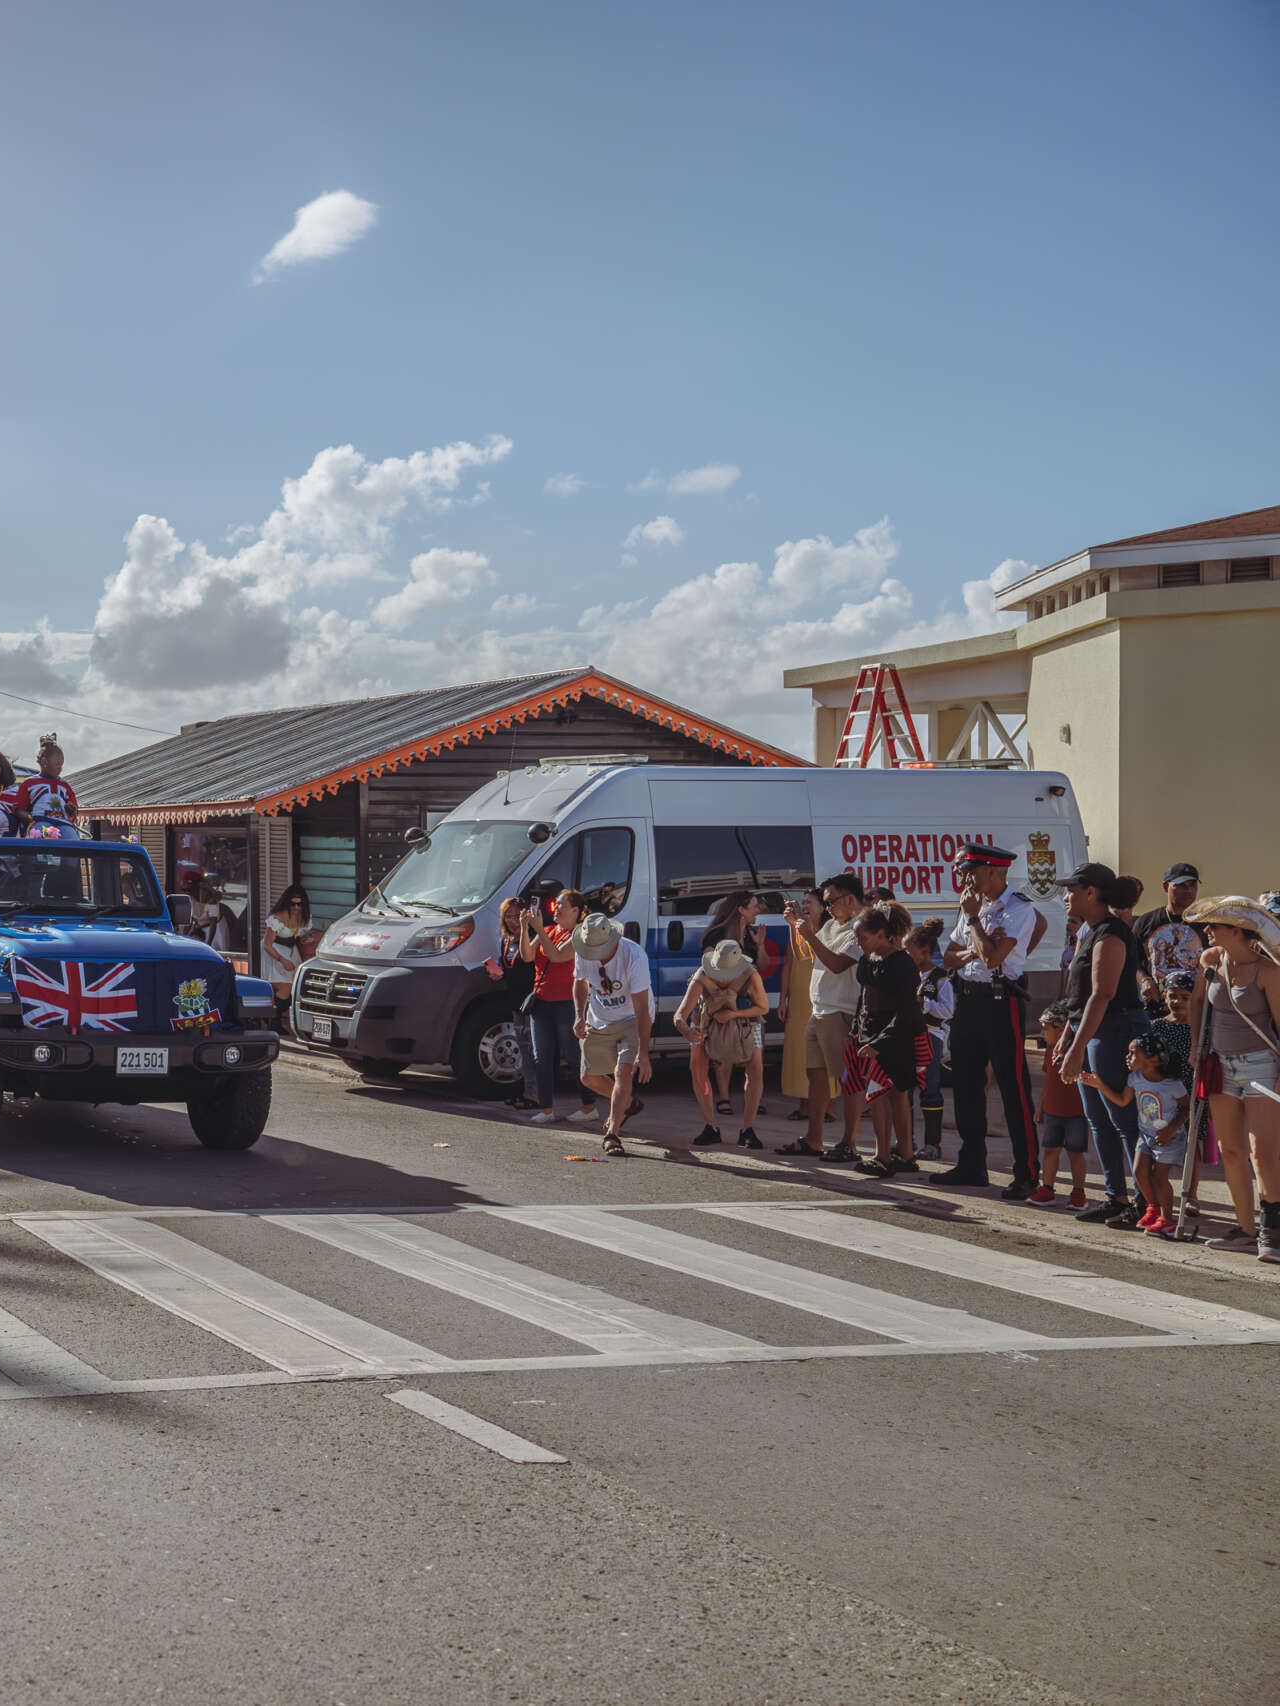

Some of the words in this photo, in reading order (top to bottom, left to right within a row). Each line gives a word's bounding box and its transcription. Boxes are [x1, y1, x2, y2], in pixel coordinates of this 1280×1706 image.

[843, 866, 944, 894] UPPORT
[121, 1052, 141, 1068] 221
[144, 1052, 164, 1068] 501
